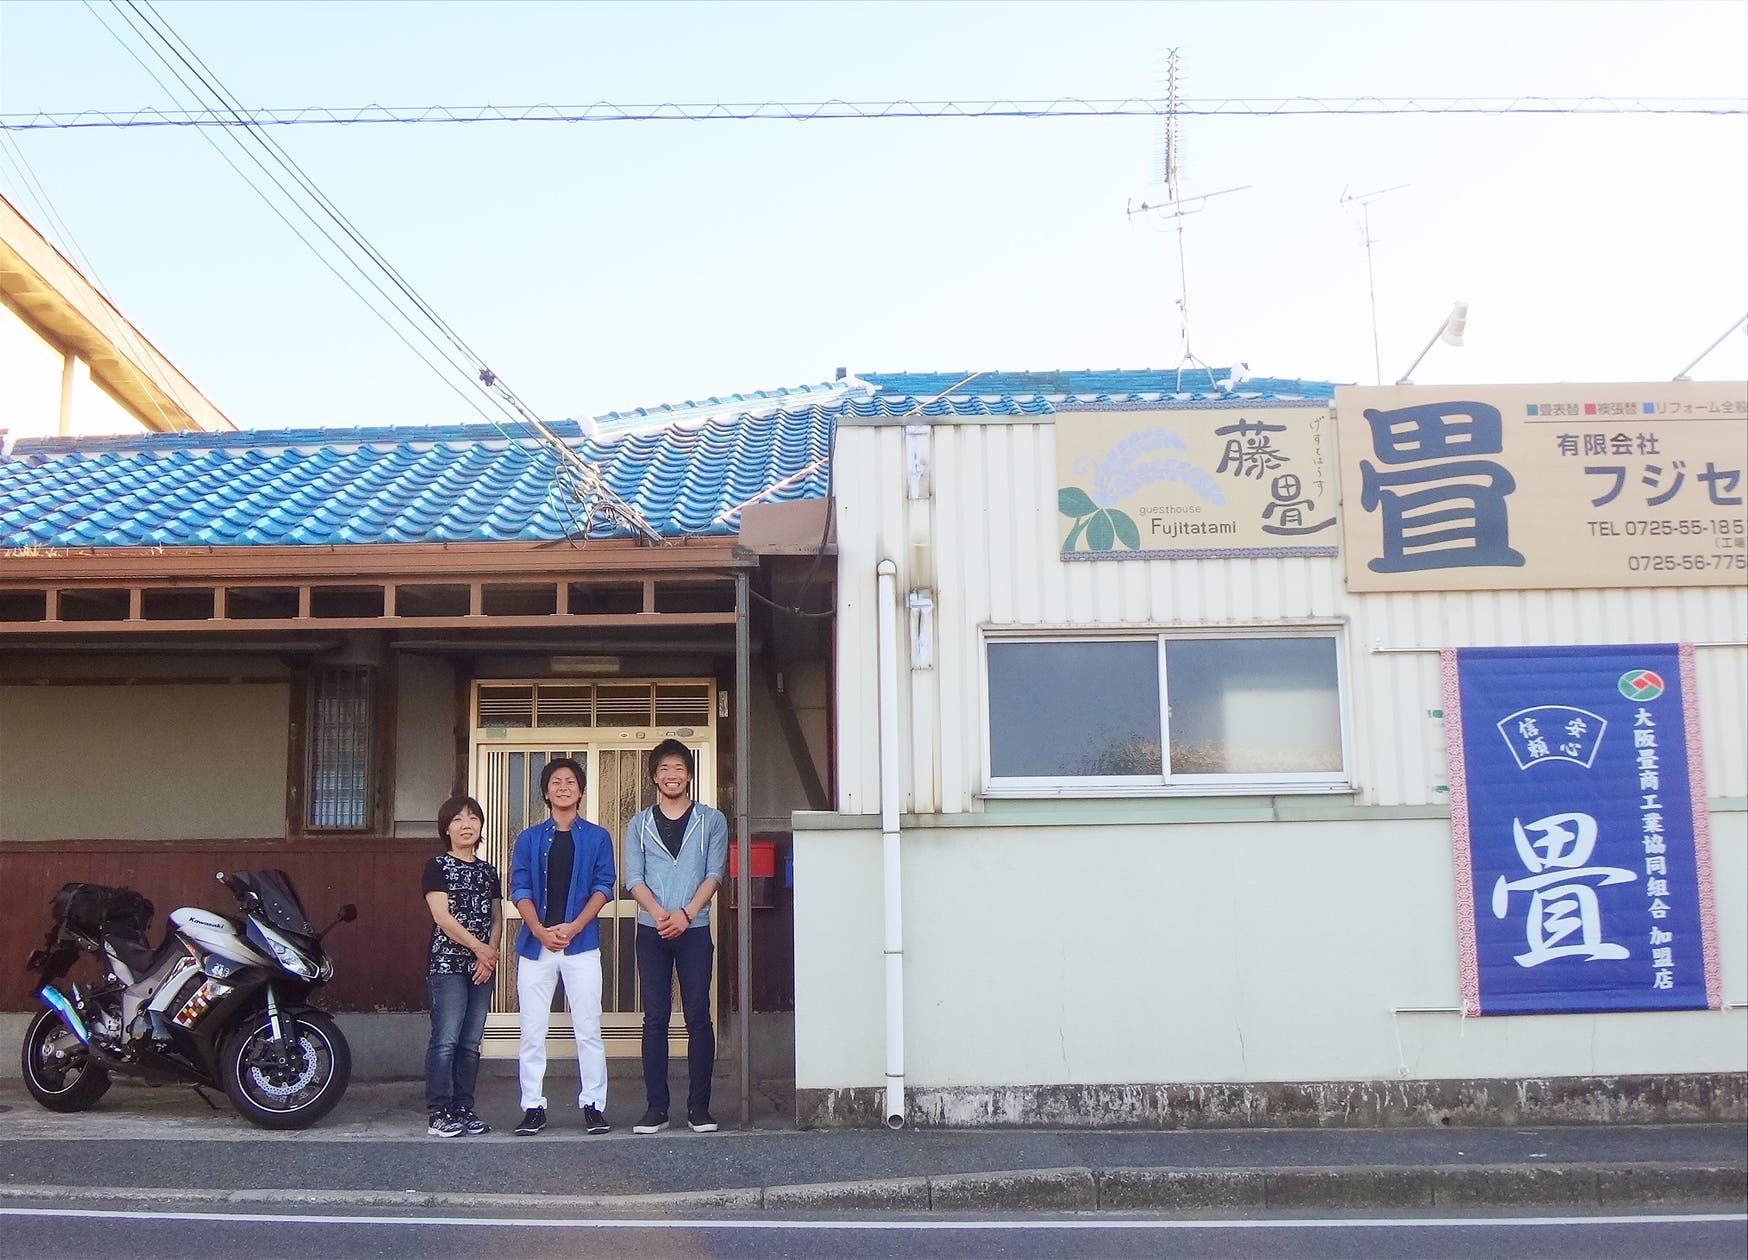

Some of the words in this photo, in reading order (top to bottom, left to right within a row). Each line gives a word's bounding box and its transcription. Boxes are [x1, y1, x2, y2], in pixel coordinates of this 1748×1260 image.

[1556, 432, 1661, 457] 有限会社
[1215, 418, 1337, 536] 藤畳
[1360, 401, 1526, 573] 畳
[1139, 504, 1201, 517] guesthouse
[1151, 518, 1236, 537] Fujitatami
[1587, 521, 1621, 536] TEL
[1518, 717, 1550, 758] 信頼
[1560, 718, 1587, 757] 安心
[1492, 812, 1638, 968] 畳
[189, 917, 224, 928] Kawasaki
[1650, 926, 1674, 990] 加盟店
